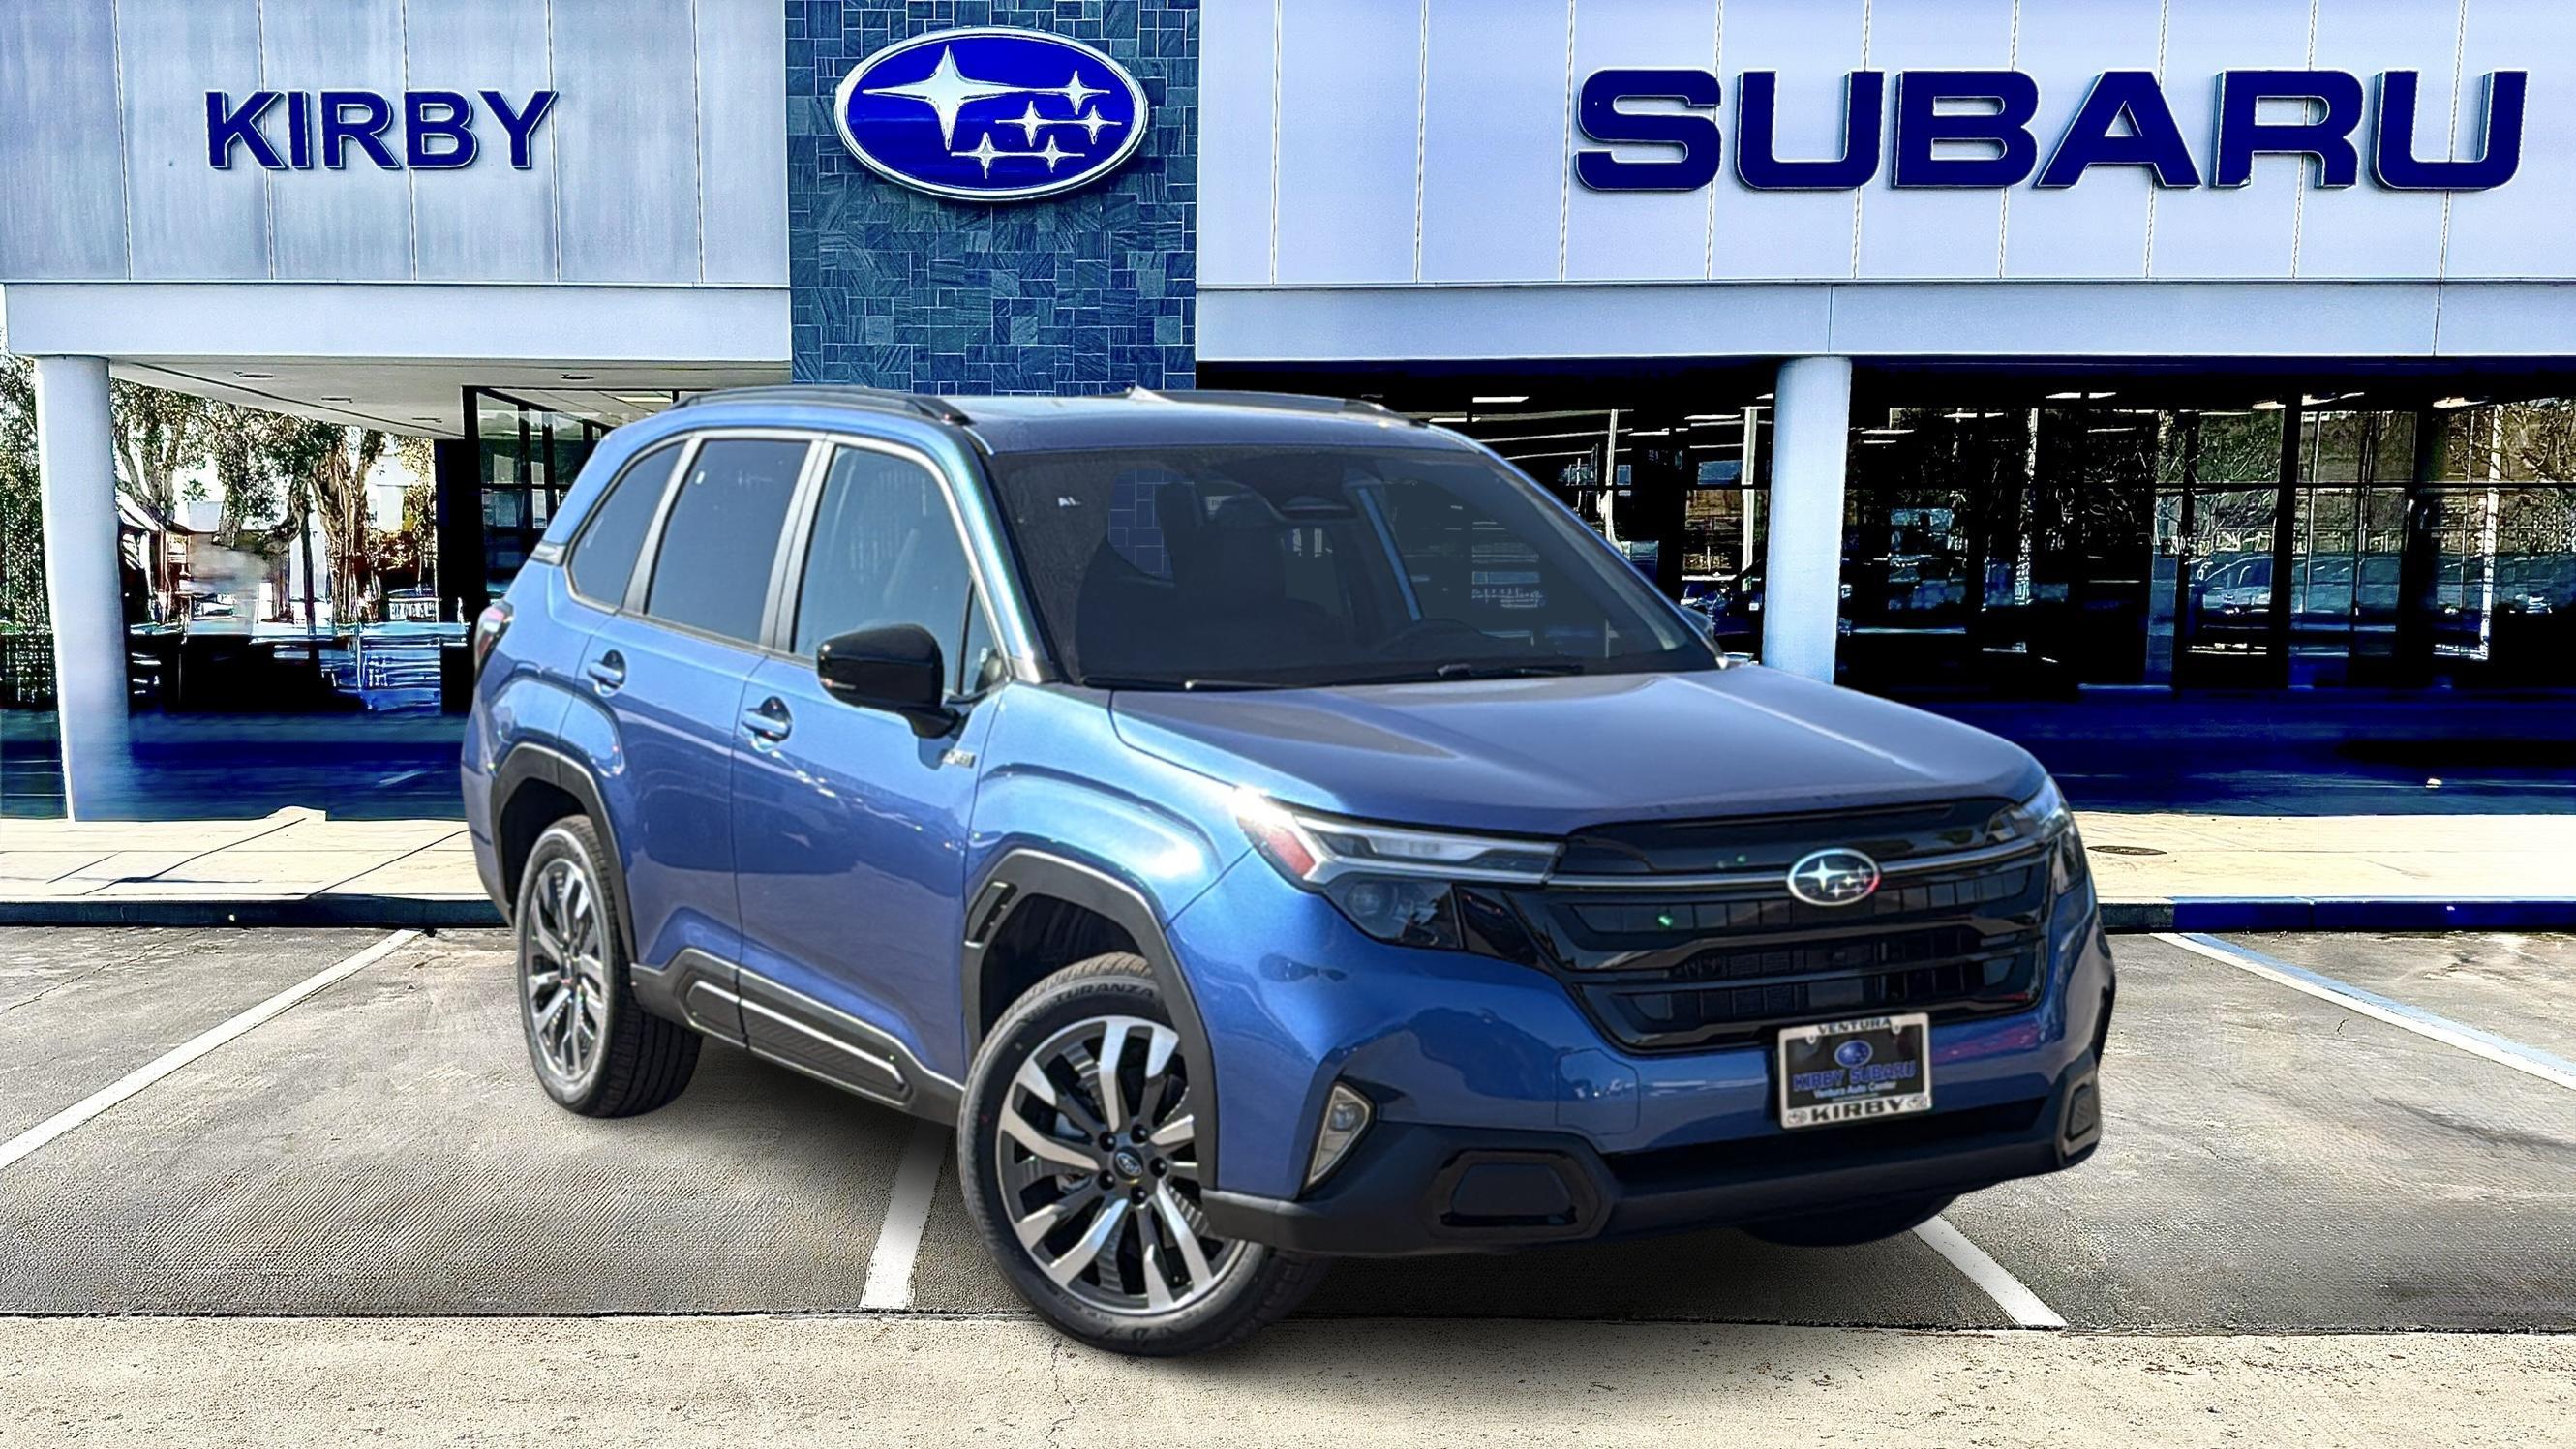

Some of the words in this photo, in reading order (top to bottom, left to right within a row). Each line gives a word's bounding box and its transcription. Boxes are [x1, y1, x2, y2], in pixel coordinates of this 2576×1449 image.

[204, 90, 559, 170] KIRBY
[1575, 68, 2529, 192] SUBARU
[1817, 1017, 1891, 1035] VENTURA
[1793, 1069, 1844, 1091] KIRBY
[1850, 1061, 1916, 1084] SUBARU
[1812, 1099, 1903, 1121] KIRBY
